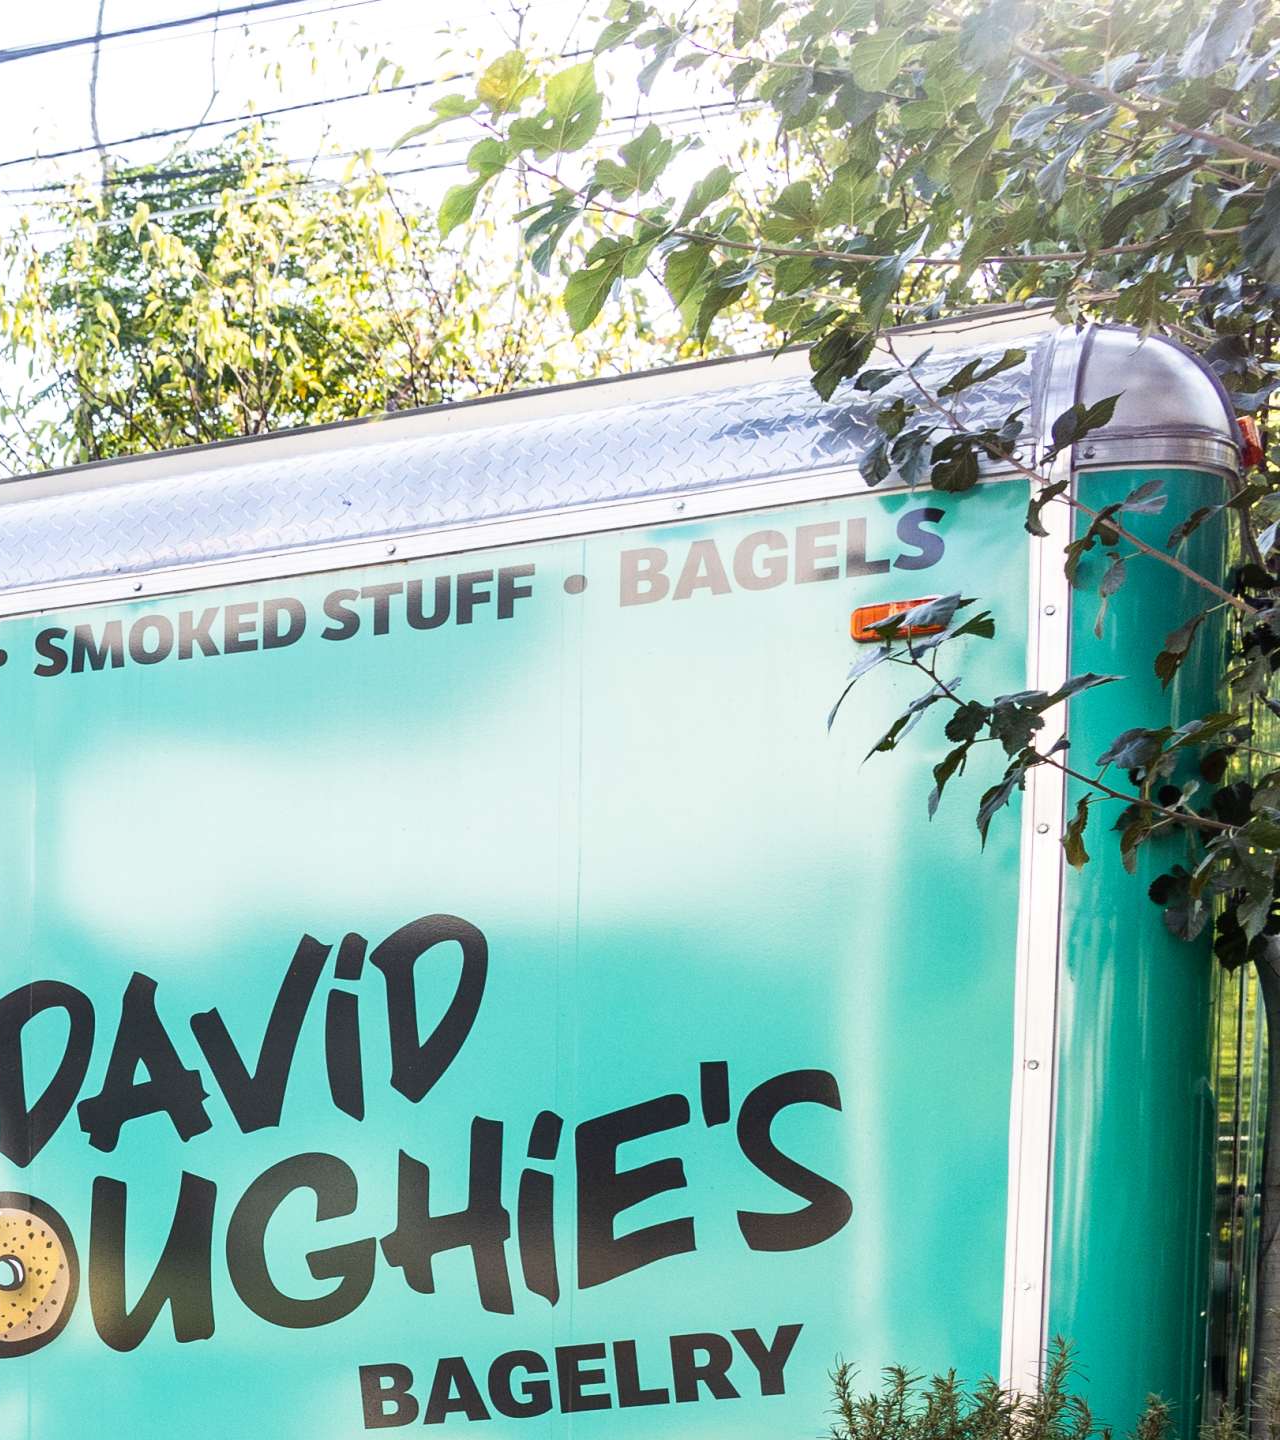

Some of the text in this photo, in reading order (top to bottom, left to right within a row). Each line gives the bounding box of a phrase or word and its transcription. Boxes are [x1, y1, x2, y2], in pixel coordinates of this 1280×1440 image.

[33, 597, 307, 678] SMOKED
[320, 563, 537, 641] STUFF
[619, 507, 947, 608] BAGELS
[358, 1322, 805, 1430] BAGELRY
